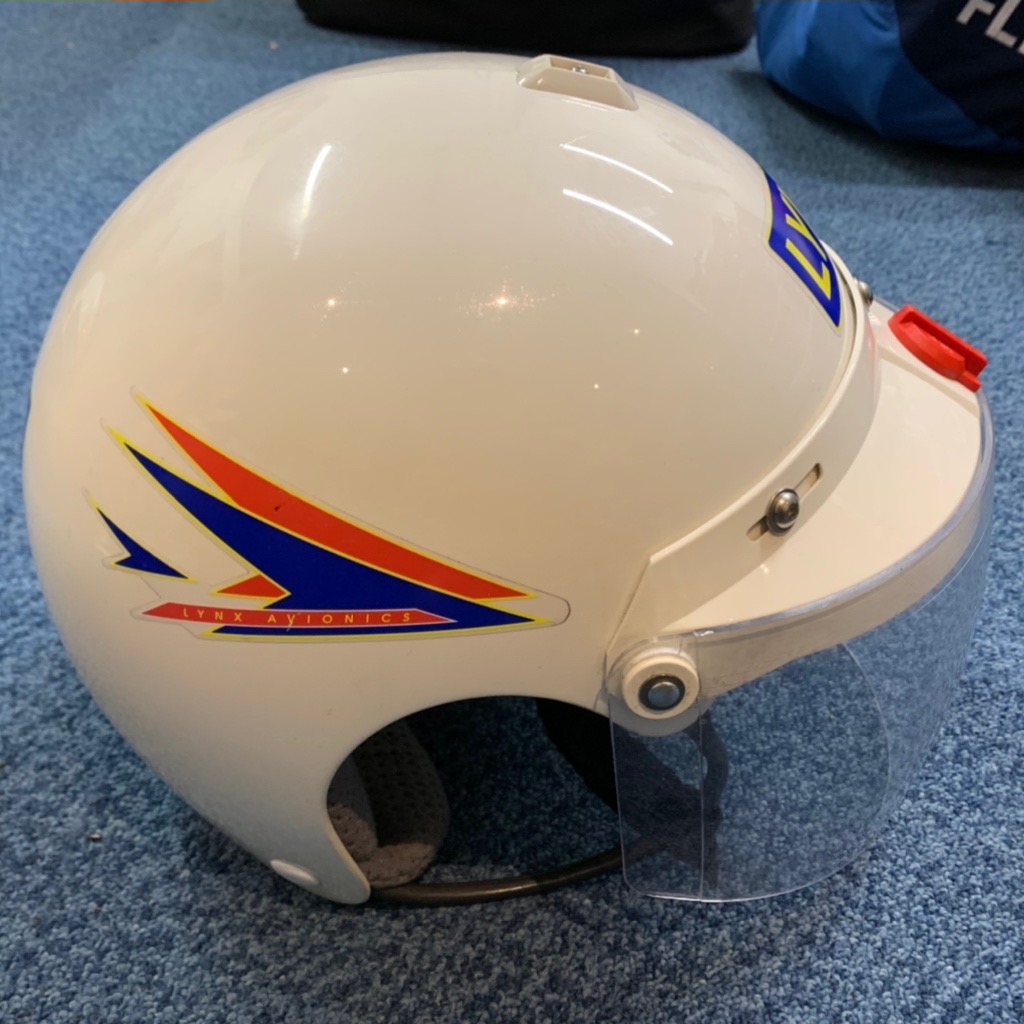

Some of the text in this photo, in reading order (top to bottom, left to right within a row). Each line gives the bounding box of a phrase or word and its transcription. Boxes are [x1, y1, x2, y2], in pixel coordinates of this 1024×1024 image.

[956, 0, 1024, 55] FL
[183, 608, 410, 625] LYNX AVIONICS
